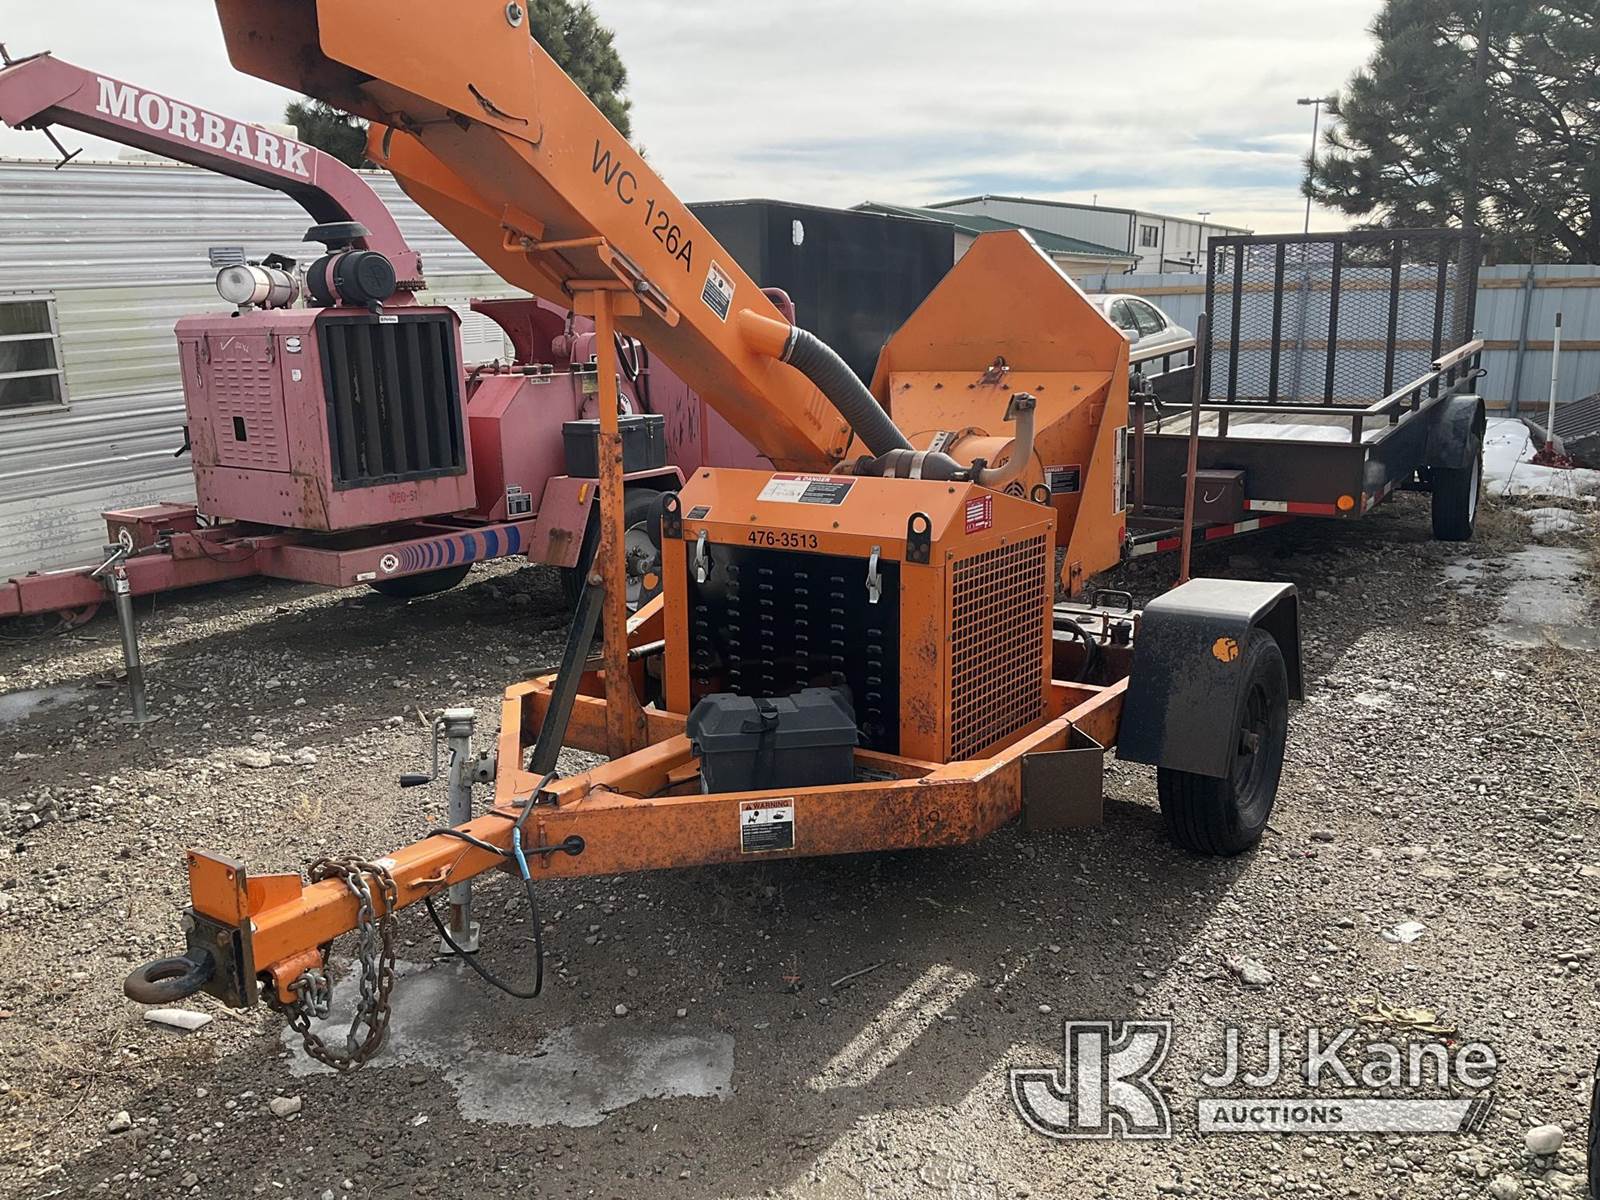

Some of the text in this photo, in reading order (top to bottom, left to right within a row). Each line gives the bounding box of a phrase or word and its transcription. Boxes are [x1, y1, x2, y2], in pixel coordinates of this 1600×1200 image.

[95, 76, 310, 178] MORBARK
[592, 138, 693, 273] WC 126A
[802, 475, 831, 483] DANGER
[748, 530, 818, 549] 476-3513
[752, 799, 789, 809] WARNING
